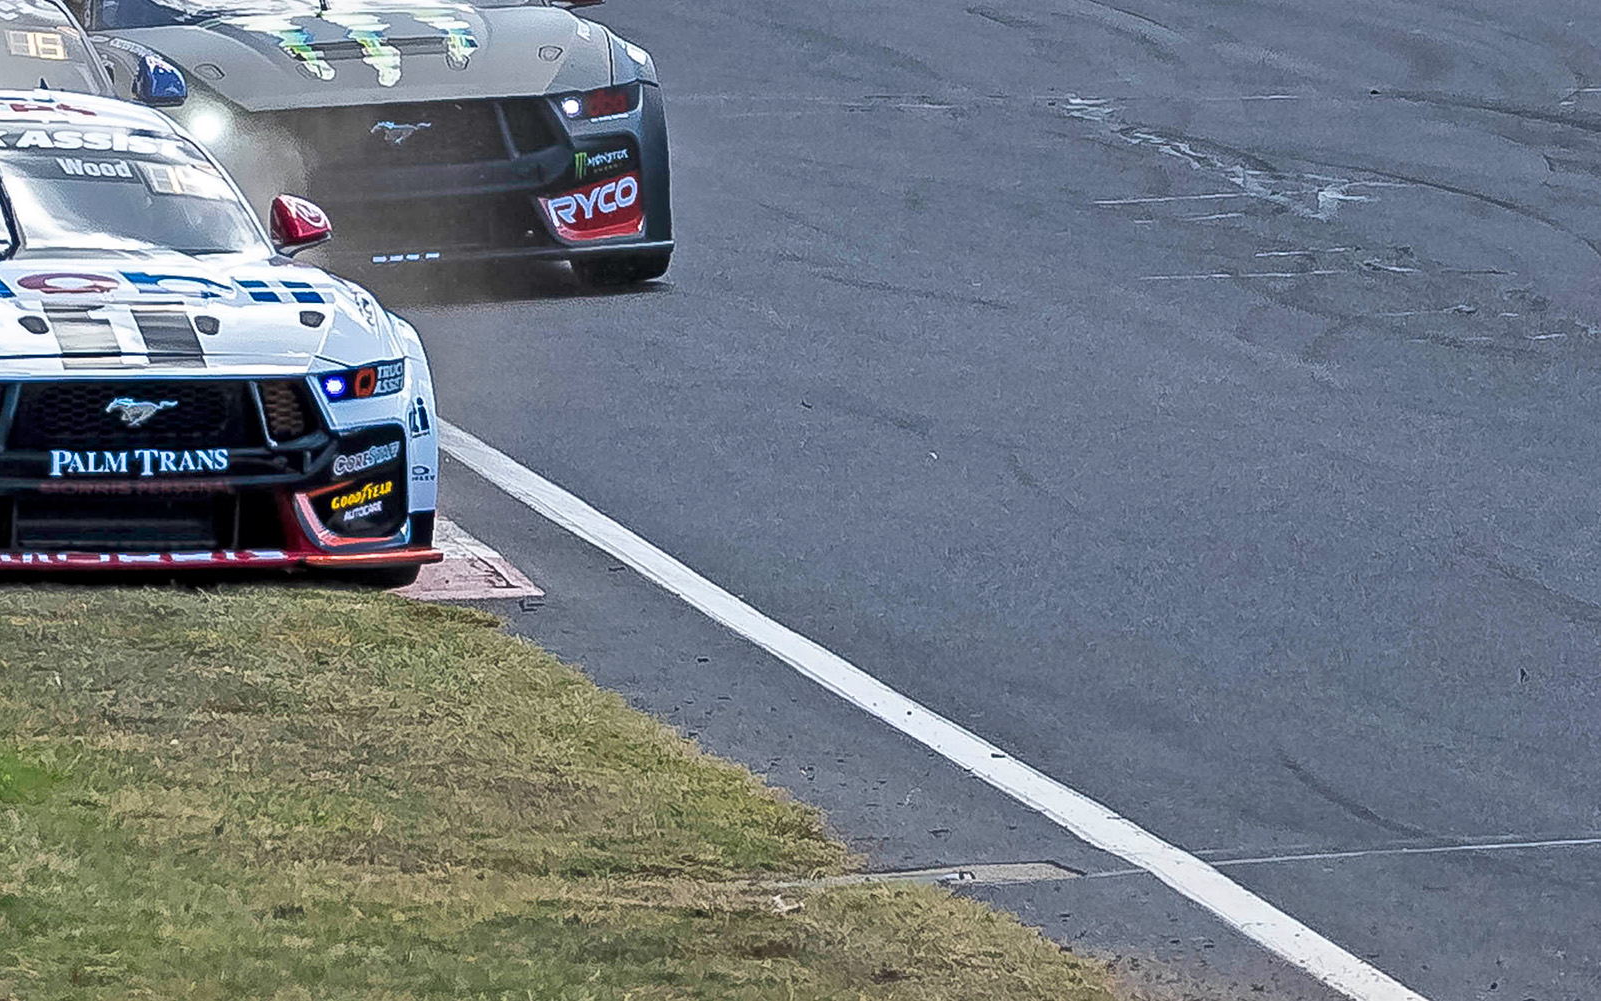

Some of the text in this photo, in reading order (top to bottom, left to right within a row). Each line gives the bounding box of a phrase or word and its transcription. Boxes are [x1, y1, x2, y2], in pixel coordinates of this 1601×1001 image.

[15, 129, 184, 158] ASSIST
[54, 157, 134, 181] Wood
[549, 175, 639, 228] RYCO
[49, 448, 230, 477] PALM TRANS
[330, 480, 393, 510] GOODYEAR
